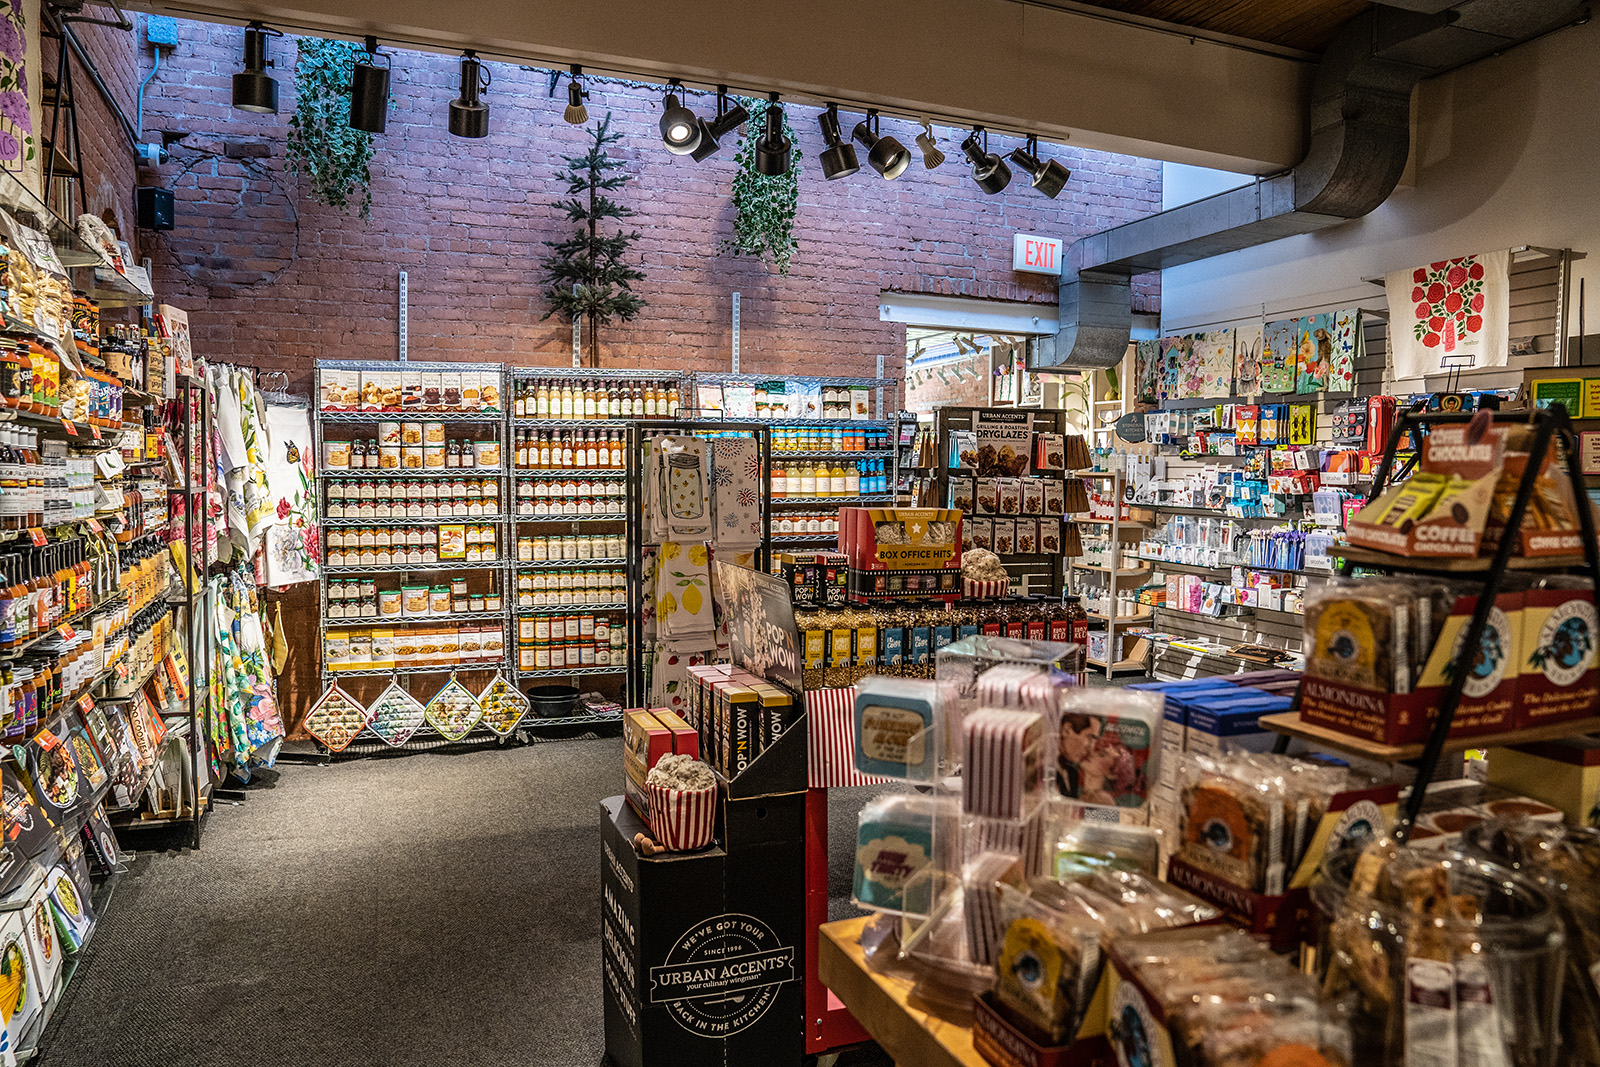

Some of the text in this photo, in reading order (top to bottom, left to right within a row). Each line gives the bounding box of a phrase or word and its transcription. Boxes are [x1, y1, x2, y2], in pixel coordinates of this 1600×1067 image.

[1025, 240, 1056, 269] EXIT
[976, 430, 1028, 439] DRYGLAZES
[1429, 428, 1466, 445] COFFEE
[1415, 525, 1476, 542] COFFEE
[880, 550, 952, 559] BOX OFFICE HITS
[1413, 541, 1476, 554] CHOCOLATES
[795, 593, 814, 601] WOW
[1053, 632, 1066, 640] RED
[1074, 631, 1087, 639] RED
[768, 641, 795, 675] WOW
[1305, 682, 1386, 714] ALMONDINA
[737, 705, 748, 737] WOW
[134, 719, 148, 754] COOKIES
[604, 883, 635, 946] AMAZING
[681, 920, 765, 951] WE'VE GOT YOUR
[604, 918, 635, 988] DELICIOUS
[704, 944, 743, 956] SINCE 1996
[659, 955, 786, 986] URBAN ACCENTS
[686, 973, 759, 991] your culinary wingman
[672, 991, 771, 1032] BACK IN THE KITCHEN
